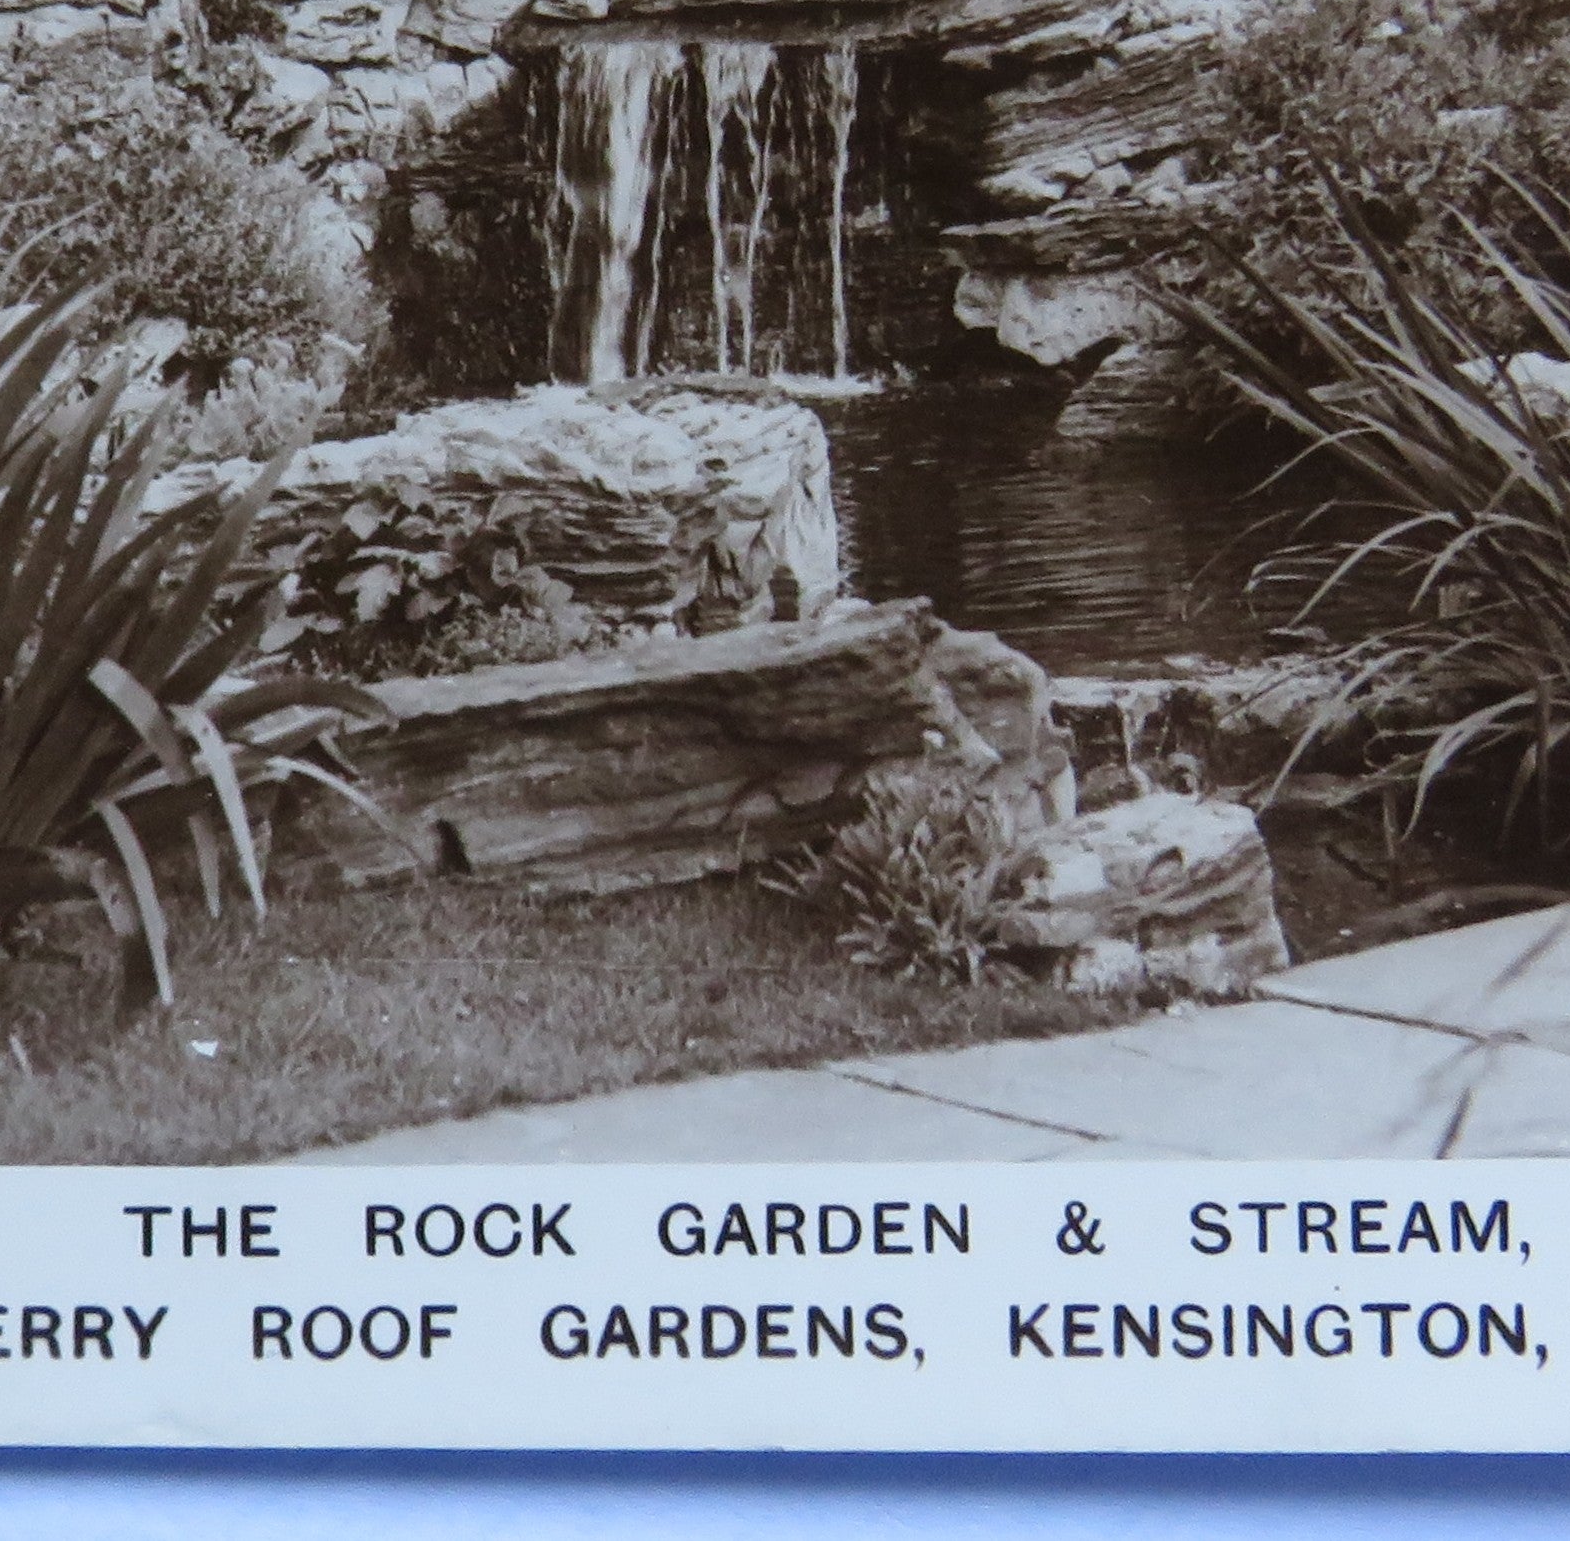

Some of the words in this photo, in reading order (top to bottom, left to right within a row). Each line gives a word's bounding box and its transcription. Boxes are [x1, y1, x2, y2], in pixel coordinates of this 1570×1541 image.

[122, 1204, 282, 1259] THE
[364, 1201, 577, 1259] ROCK
[656, 1200, 971, 1258] GARDEN
[1055, 1200, 1107, 1256] &
[1189, 1198, 1532, 1263] STREAM,
[251, 1303, 460, 1362] ROOF
[539, 1302, 927, 1367] GARDENS,
[1007, 1301, 1550, 1368] KENSINGTON,
